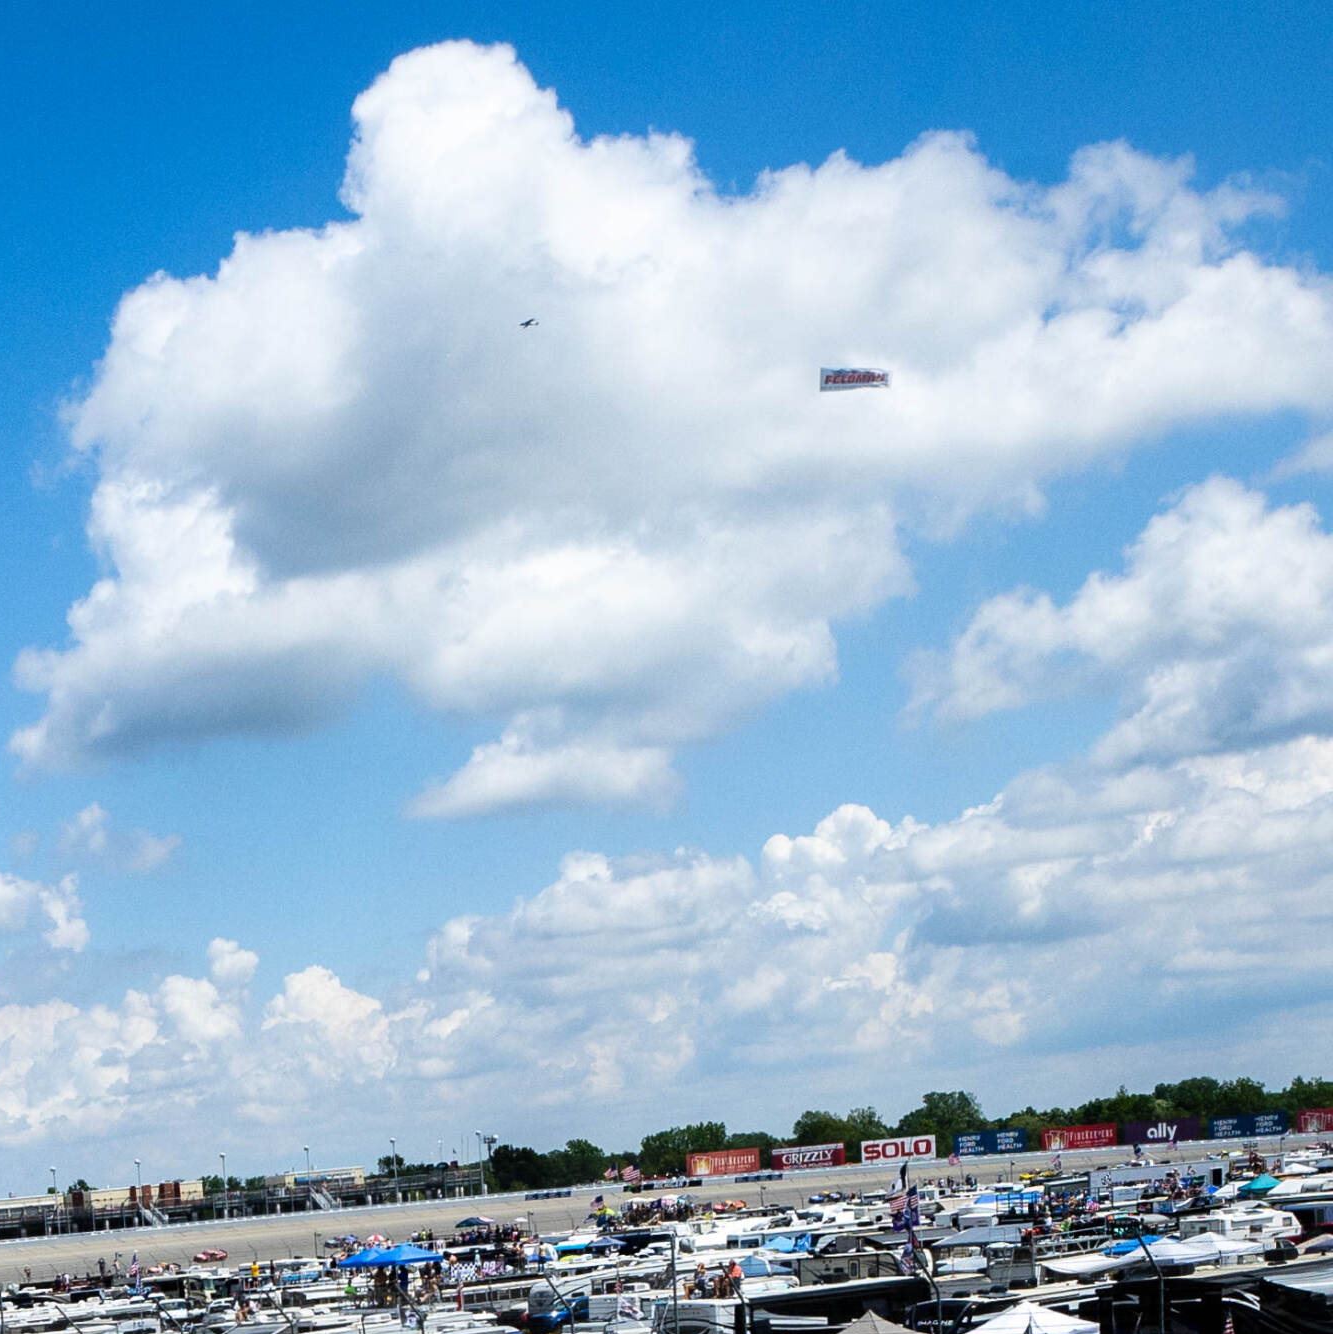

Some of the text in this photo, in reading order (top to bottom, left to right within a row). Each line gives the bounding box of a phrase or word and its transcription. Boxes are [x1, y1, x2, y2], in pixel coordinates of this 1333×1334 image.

[1147, 1123, 1177, 1140] ally
[782, 1149, 833, 1166] GRIZZLY
[863, 1139, 932, 1160] SOLO
